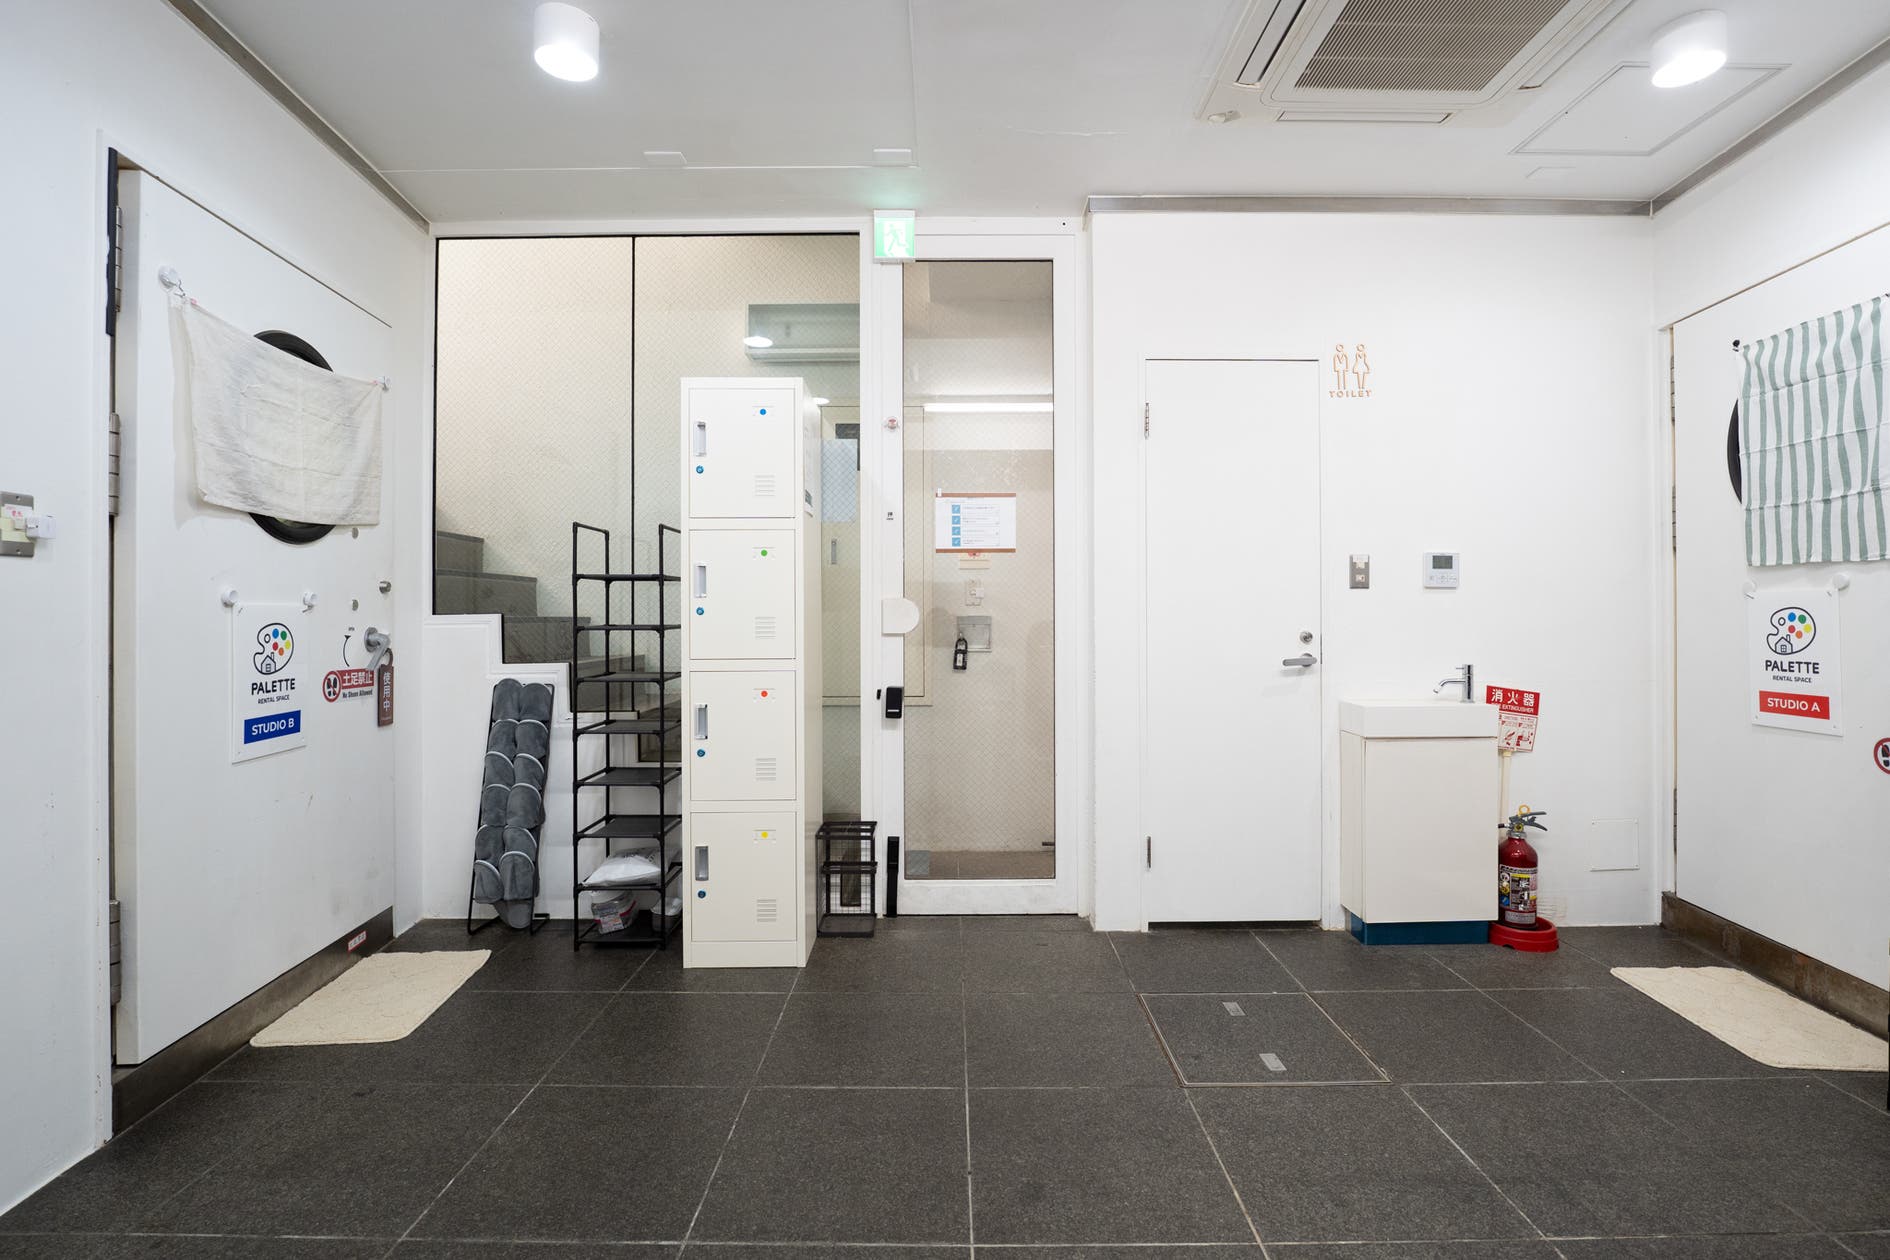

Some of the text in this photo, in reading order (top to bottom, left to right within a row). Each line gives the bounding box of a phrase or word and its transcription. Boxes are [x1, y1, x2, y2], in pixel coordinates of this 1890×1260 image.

[1329, 390, 1371, 398] TOILET
[1765, 660, 1820, 674] PALETTE
[343, 671, 373, 686] 土足禁止
[251, 678, 295, 695] PALETTE
[383, 671, 391, 711] 使用中
[276, 694, 290, 702] SPACE
[1491, 688, 1535, 707] 消火器
[1502, 704, 1534, 713] EXTINGUISHER
[1767, 698, 1821, 712] STUDIO A
[251, 718, 295, 735] STUDIO B
